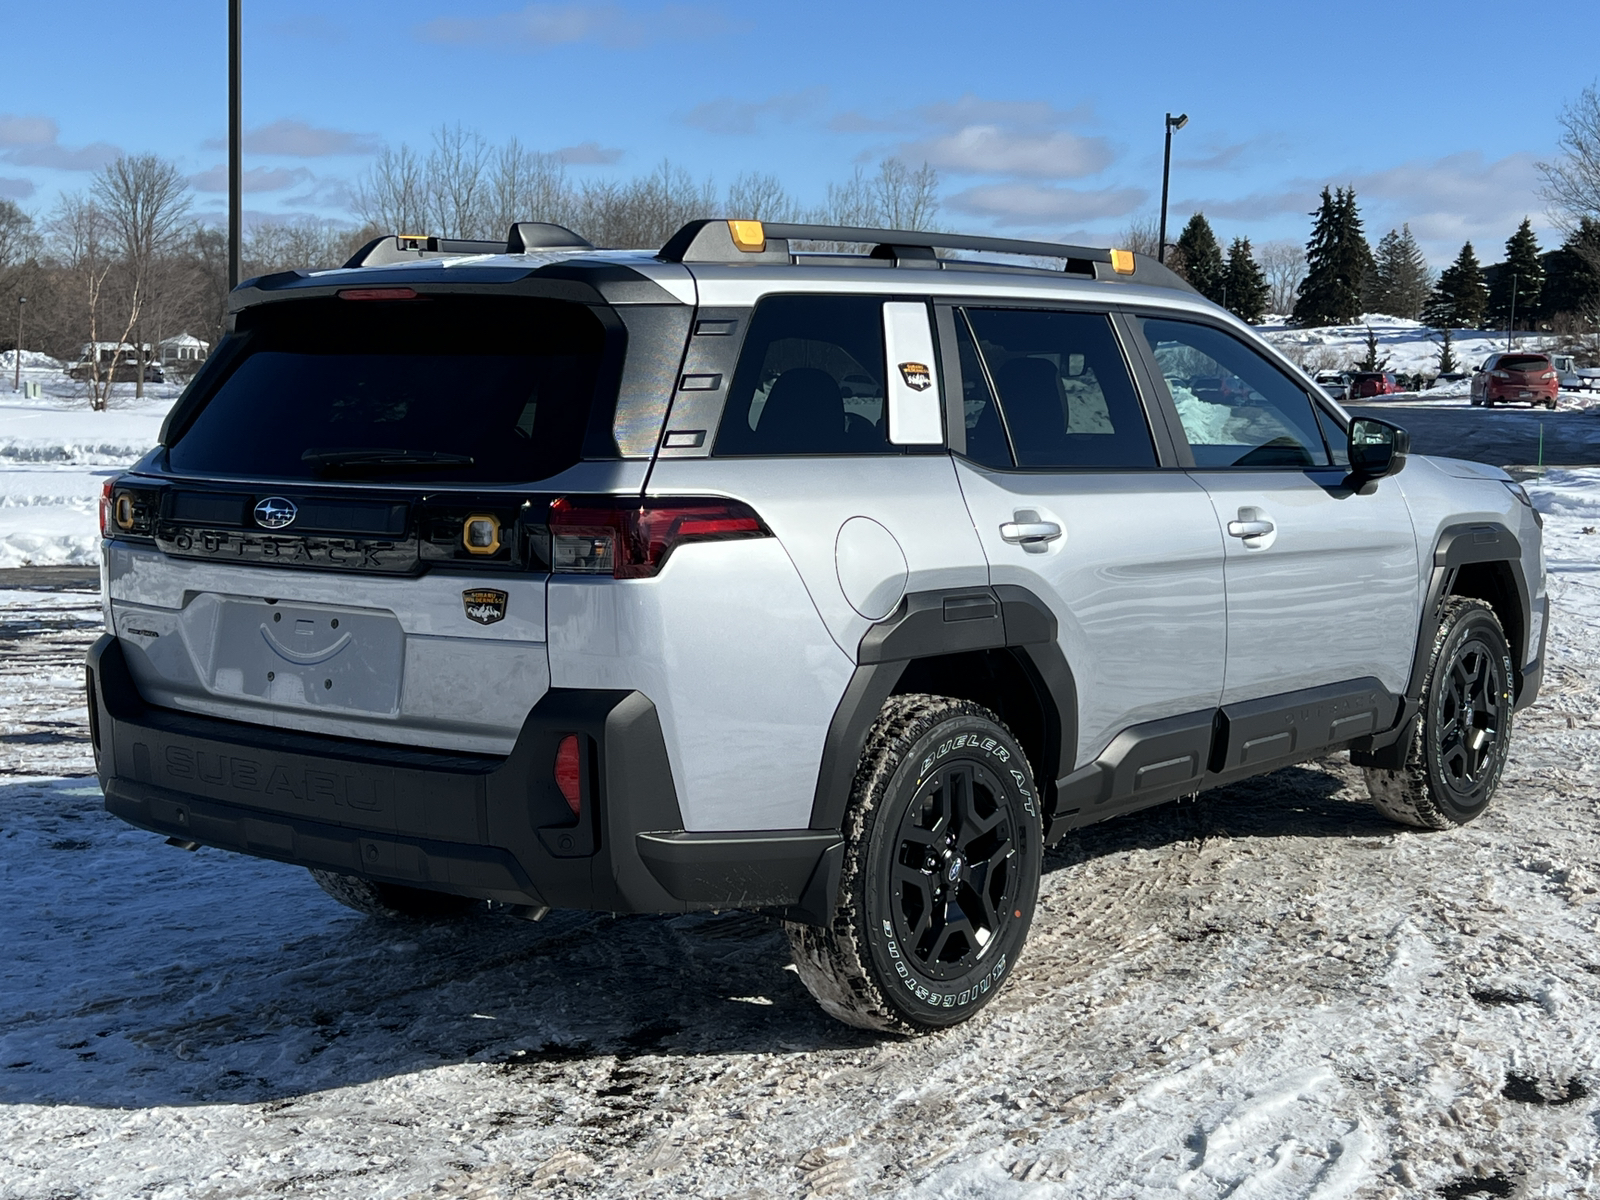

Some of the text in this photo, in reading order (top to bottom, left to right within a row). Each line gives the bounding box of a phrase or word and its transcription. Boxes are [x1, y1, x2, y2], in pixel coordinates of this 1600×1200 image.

[173, 533, 382, 567] OUTBACK
[164, 744, 385, 812] SUBARU
[919, 733, 1036, 818] DUELER A/T
[882, 919, 1007, 1007] BRIDGESTONE
